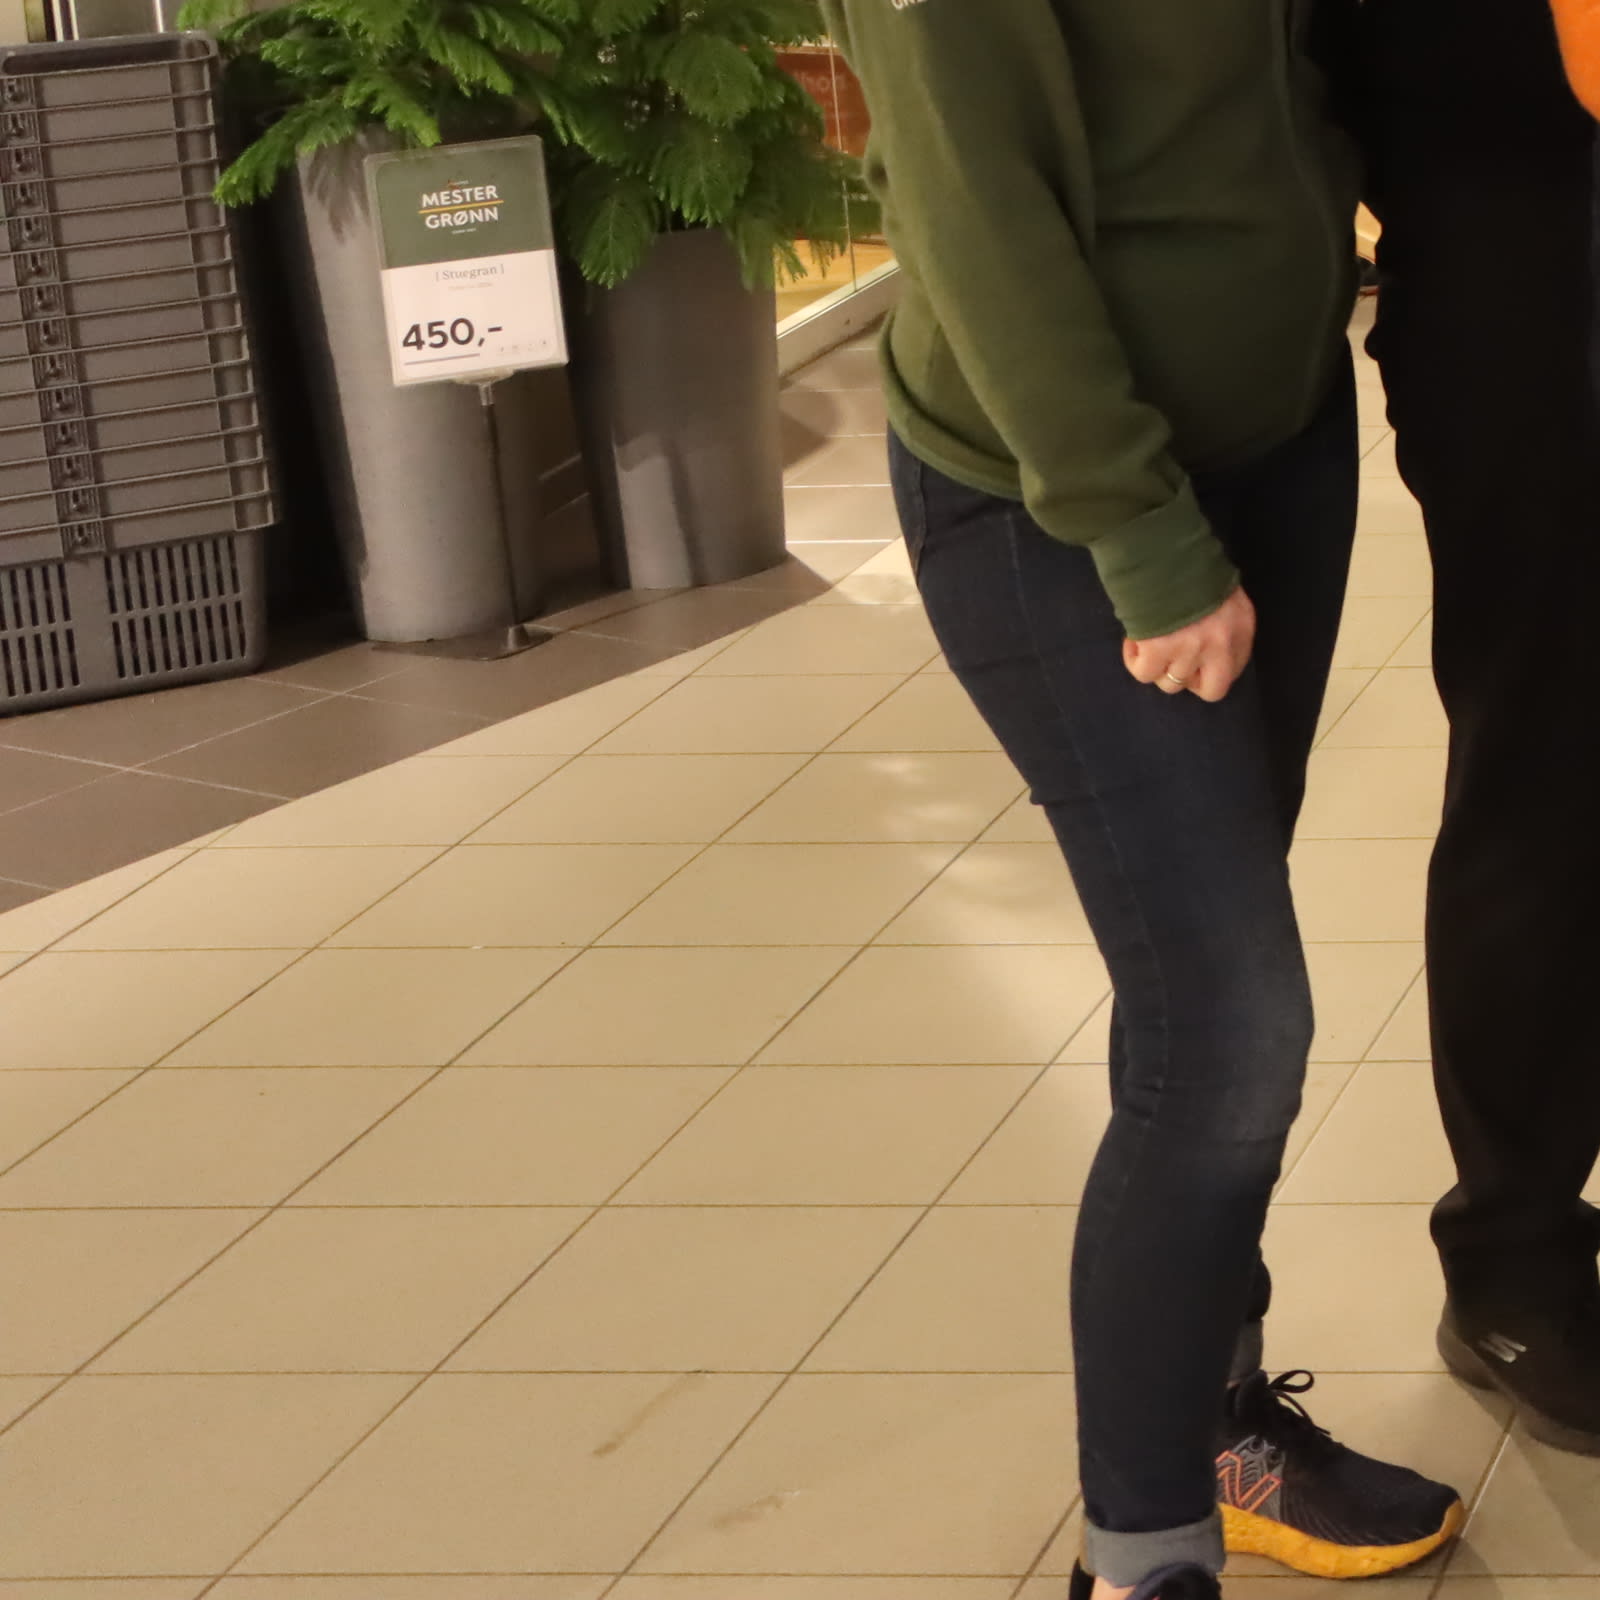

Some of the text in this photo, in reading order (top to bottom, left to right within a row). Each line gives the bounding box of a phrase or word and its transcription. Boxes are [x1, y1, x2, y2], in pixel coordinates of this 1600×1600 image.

[422, 184, 499, 208] MESTER
[425, 206, 499, 229] GRØNN
[442, 264, 498, 281] Stuegran
[402, 318, 503, 351] 450,-
